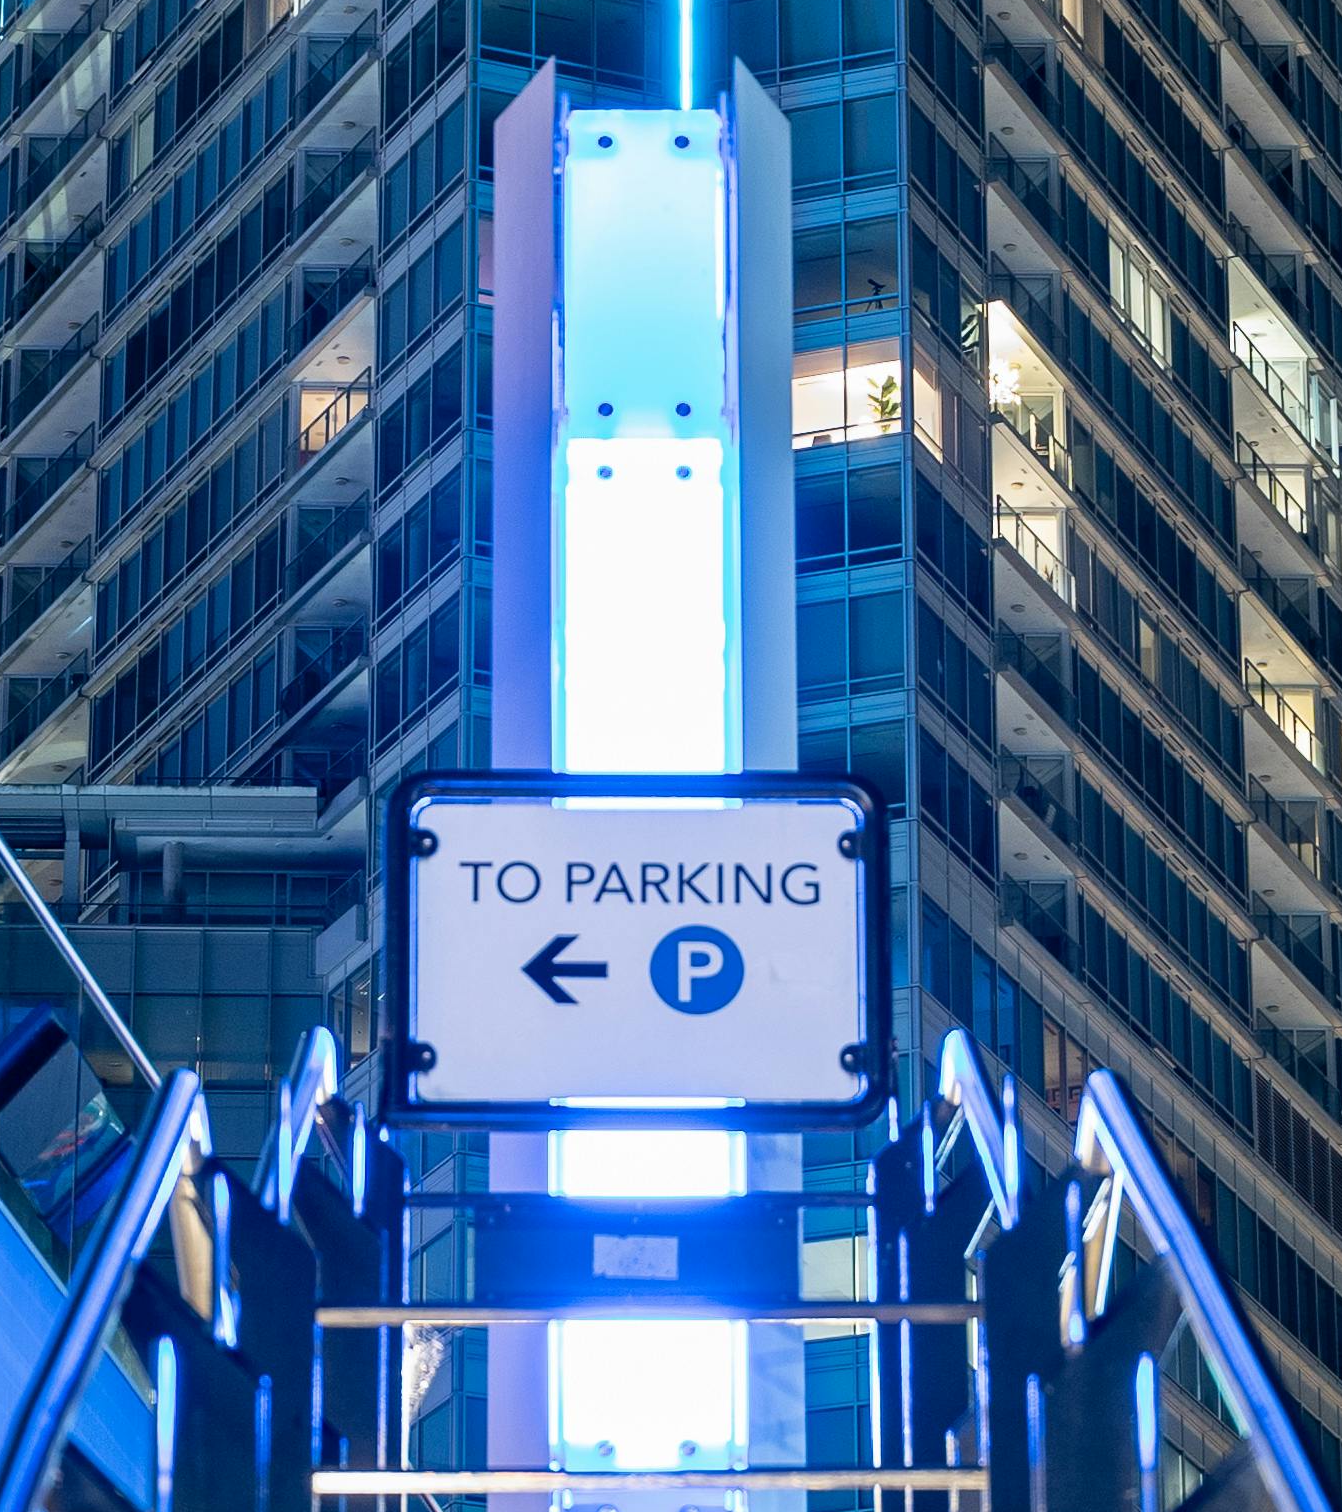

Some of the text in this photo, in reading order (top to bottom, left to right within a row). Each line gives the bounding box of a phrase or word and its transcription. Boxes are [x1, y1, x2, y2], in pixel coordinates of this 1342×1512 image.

[460, 862, 822, 905] TO PARKING
[677, 941, 724, 1002] P
